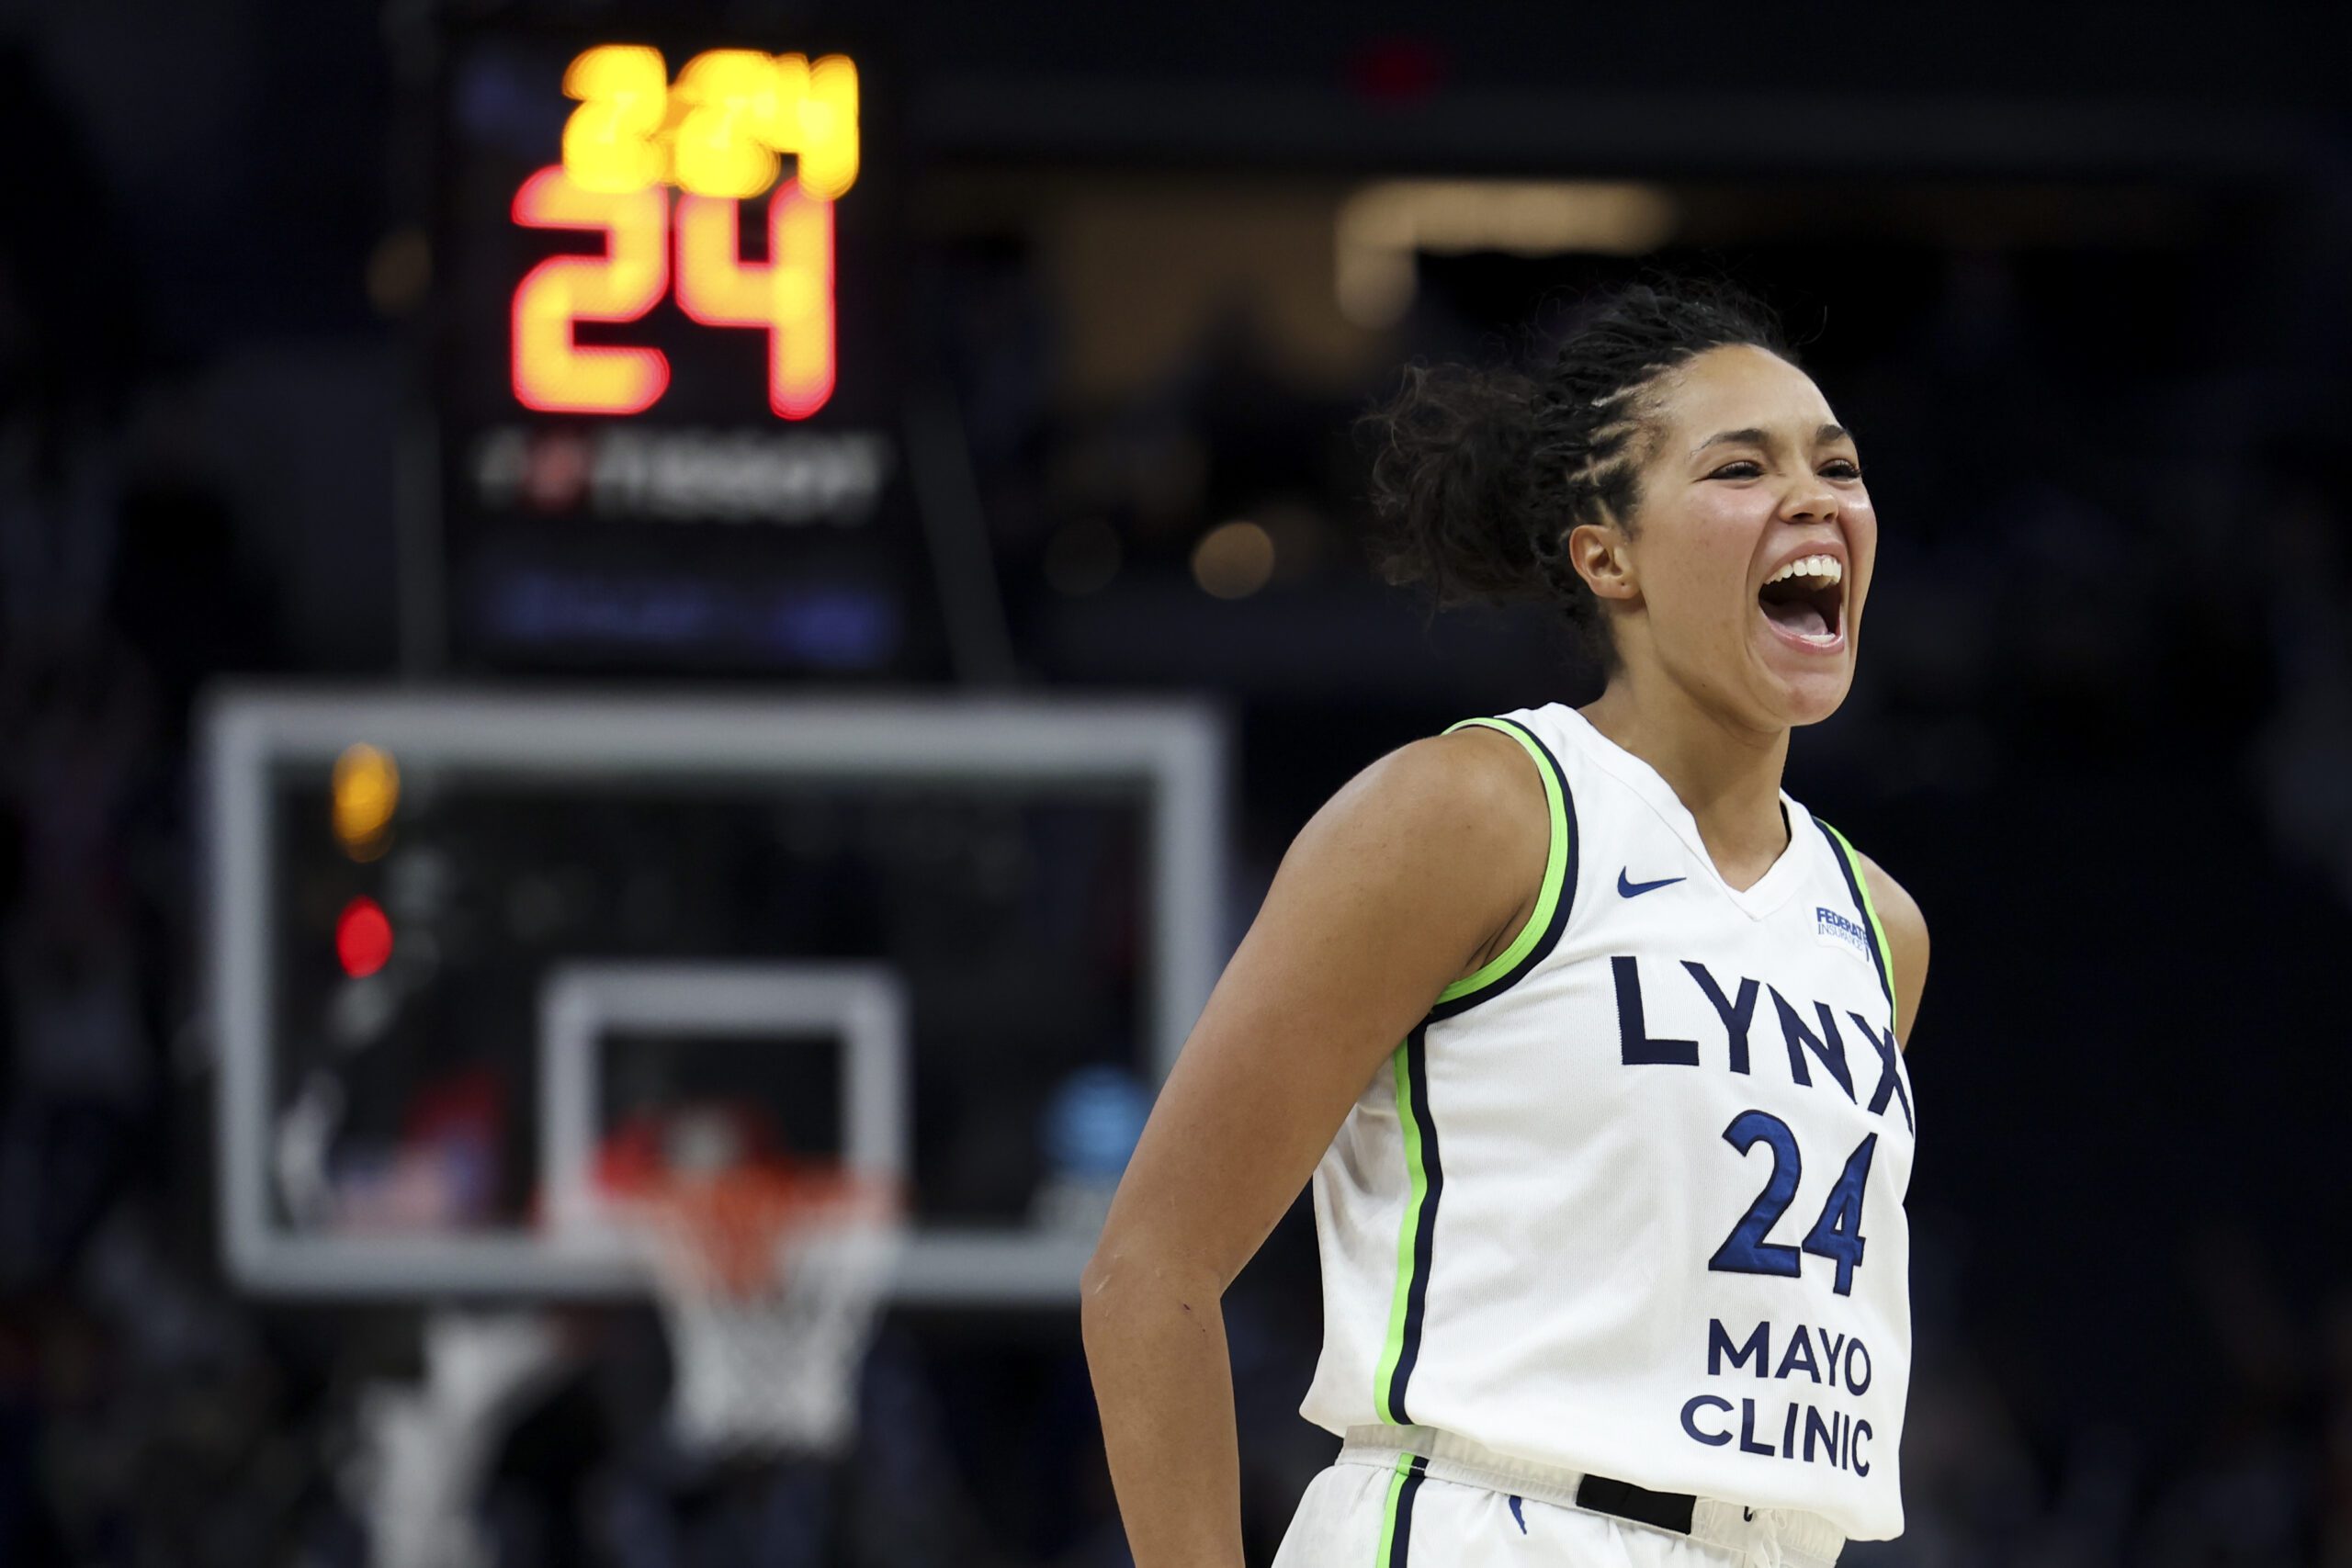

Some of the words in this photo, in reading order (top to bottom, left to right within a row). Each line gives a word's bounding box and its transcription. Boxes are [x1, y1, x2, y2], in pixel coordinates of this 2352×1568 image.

[511, 164, 835, 420] 24
[1611, 955, 1914, 1138] LYNX
[1708, 1109, 1878, 1297] 24
[1679, 1394, 1873, 1477] CLINIC
[1707, 1318, 1871, 1396] MAYO
